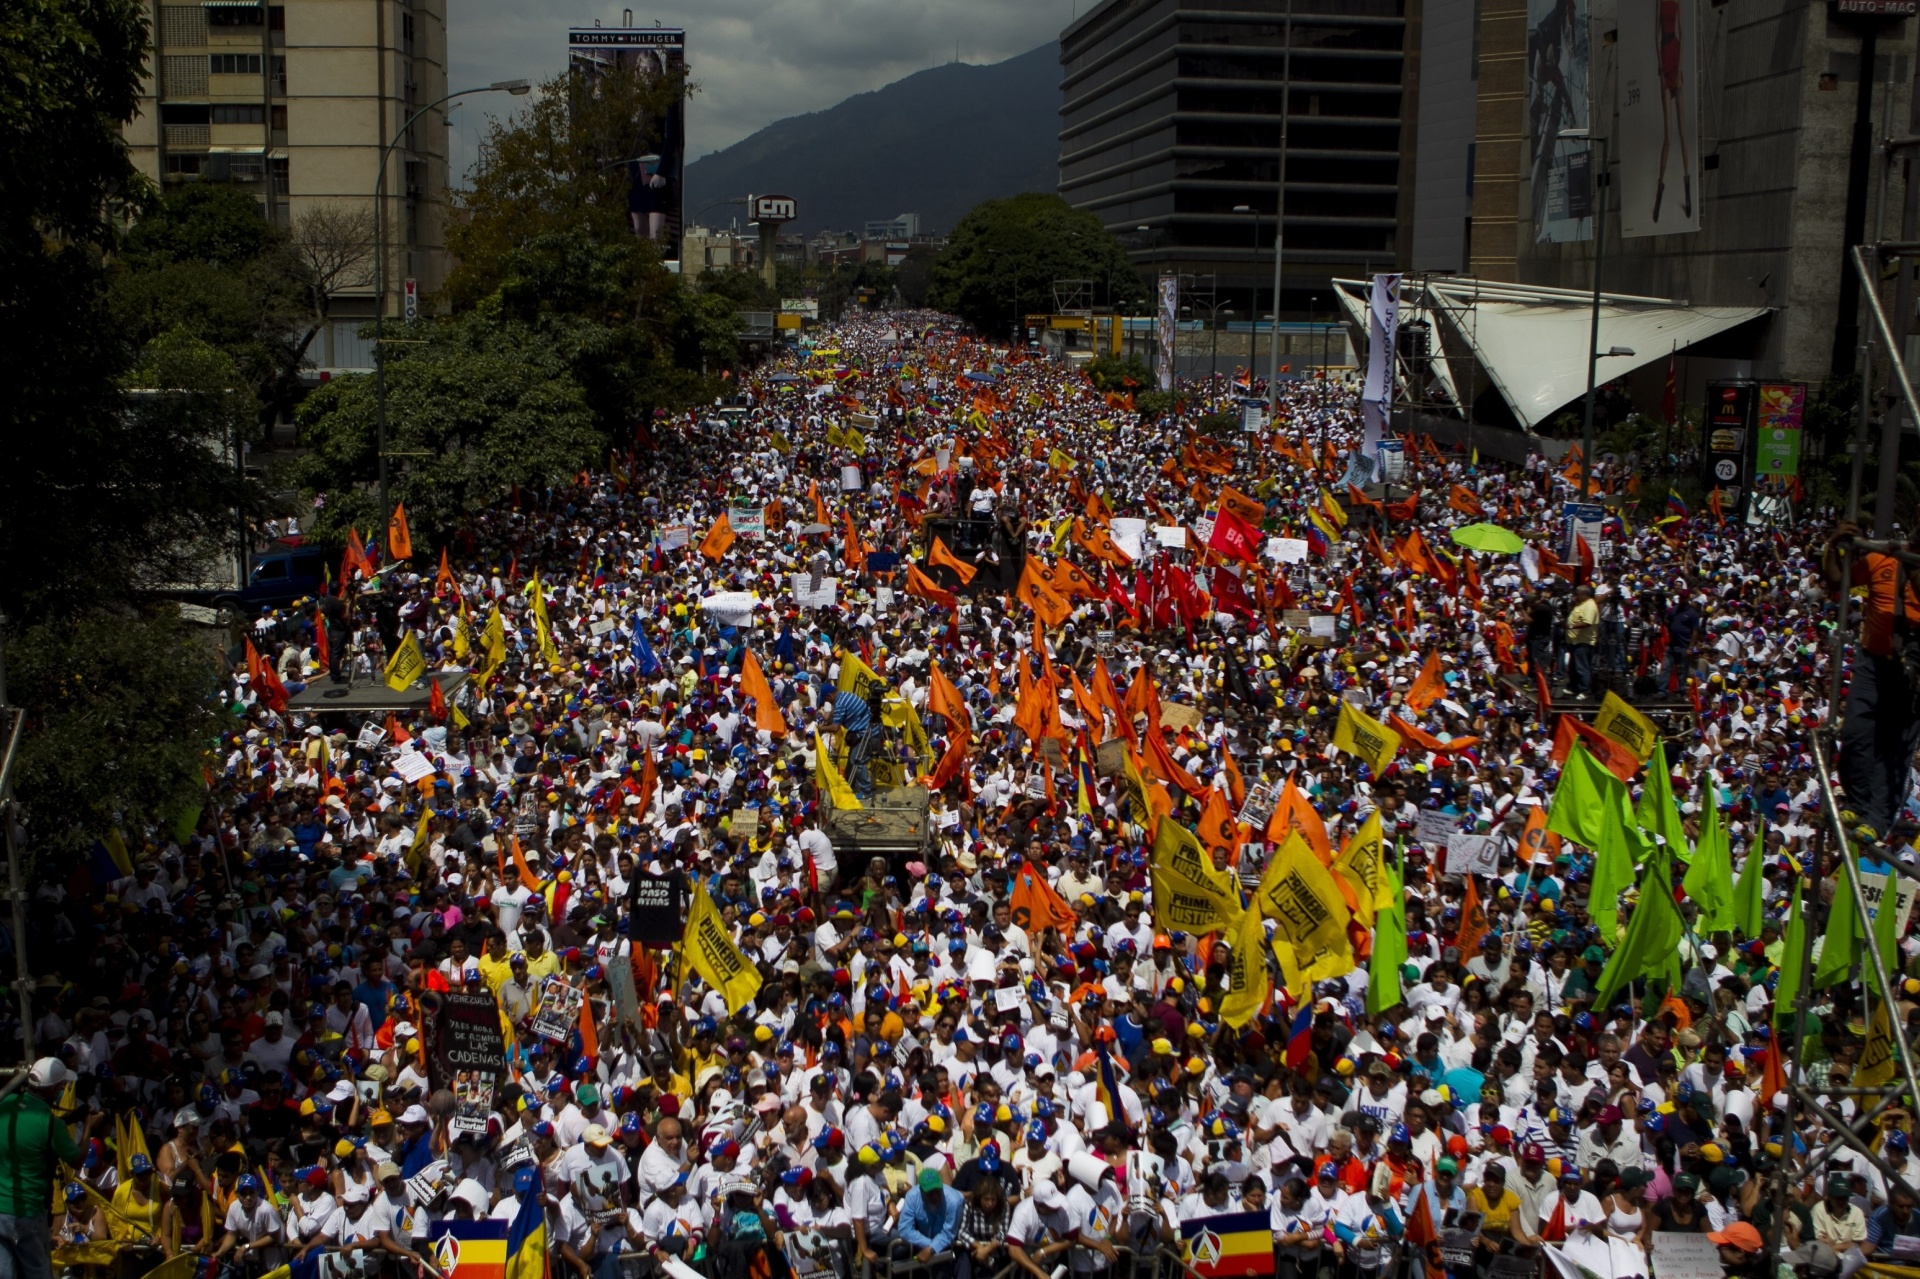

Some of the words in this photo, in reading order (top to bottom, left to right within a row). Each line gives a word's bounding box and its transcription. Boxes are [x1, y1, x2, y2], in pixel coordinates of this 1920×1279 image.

[1839, 1, 1916, 14] AUTO-MAC
[575, 34, 616, 43] TOMMY
[630, 34, 676, 43] HILFIGER
[1627, 87, 1641, 106] 399
[1718, 464, 1733, 476] 73
[1224, 527, 1244, 549] BR
[640, 880, 653, 889] NI
[655, 880, 670, 889] UN
[640, 889, 669, 898] PASO
[596, 947, 617, 957] VANS
[445, 993, 495, 1005] VENEZUELA
[473, 1024, 493, 1035] HORA
[533, 1023, 566, 1040] Libertad
[454, 1031, 467, 1040] DE
[469, 1032, 501, 1044] ROMPER
[469, 1040, 489, 1052] LAS
[1359, 1104, 1389, 1119] SHUT
[455, 1119, 487, 1132] Libertad
[1442, 1252, 1471, 1264] erde
